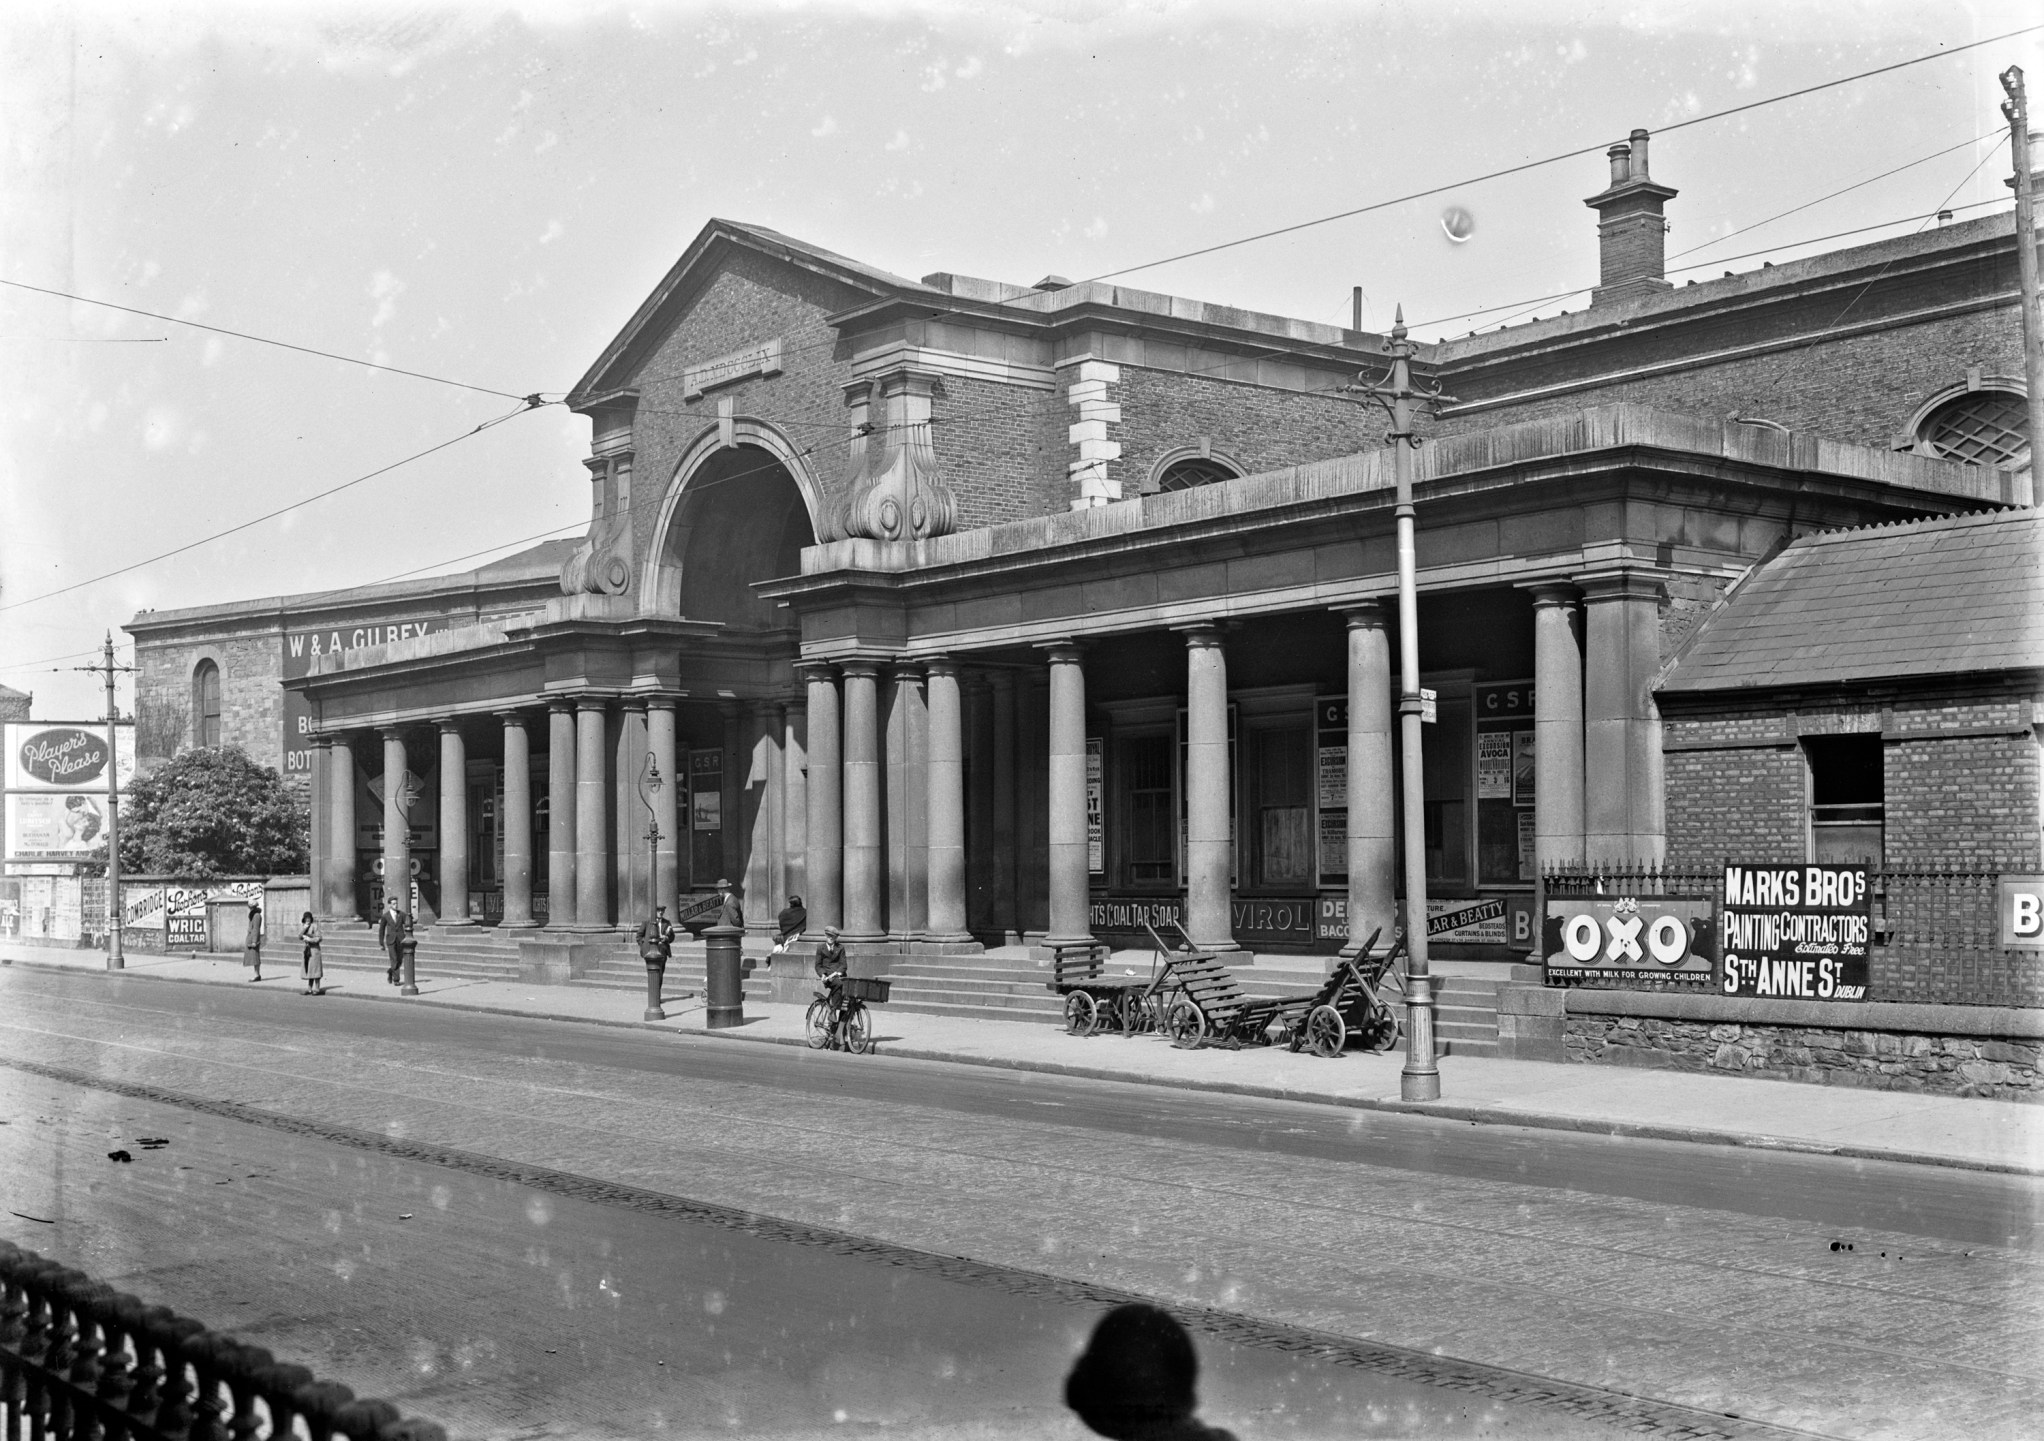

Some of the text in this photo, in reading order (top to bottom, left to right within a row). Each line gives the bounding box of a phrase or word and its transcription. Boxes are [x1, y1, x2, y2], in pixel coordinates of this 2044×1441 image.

[289, 634, 305, 658] W
[310, 633, 322, 656] &
[24, 732, 88, 772] Player's
[1479, 741, 1510, 750] EXCURSION
[1480, 749, 1509, 758] AVOCA
[48, 751, 101, 782] Please
[1726, 867, 1800, 906] MARKS
[126, 890, 164, 926] COMBRIDGE
[1106, 903, 1132, 926] COAL
[1131, 904, 1150, 927] TAR
[1152, 904, 1179, 928] SOAP
[1233, 904, 1310, 931] VIROL
[1459, 900, 1504, 927] BEATTY
[1566, 914, 1690, 966] OXO
[1724, 911, 1868, 950] PAINTING CONTRACTORS
[1549, 969, 1582, 977] EXCELLENT
[1584, 970, 1600, 978] WITH
[1638, 972, 1671, 980] GROWING
[1674, 973, 1711, 981] CHILDREN
[1756, 956, 1816, 996] ANNE
[1833, 985, 1866, 999] DUBLIN
